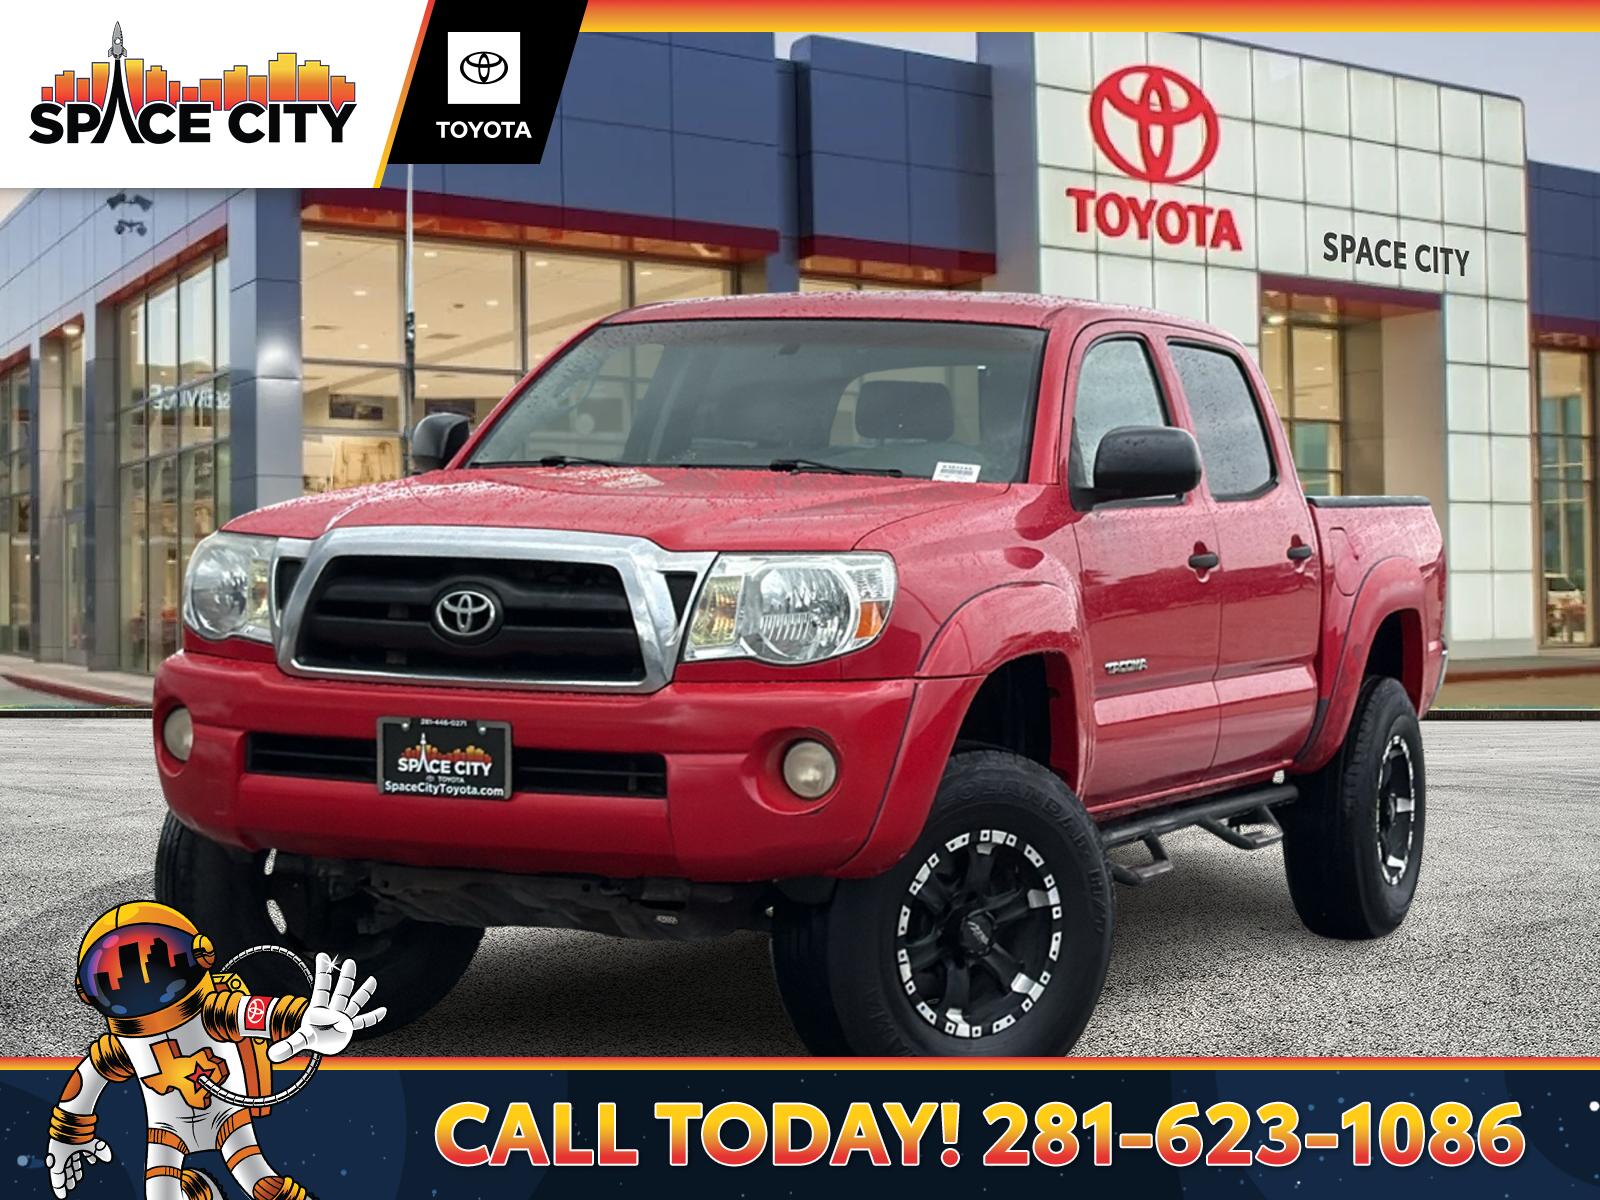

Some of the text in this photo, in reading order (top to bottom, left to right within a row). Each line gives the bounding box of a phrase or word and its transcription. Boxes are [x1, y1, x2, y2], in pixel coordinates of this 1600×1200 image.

[1066, 187, 1243, 251] TOYOTA
[1323, 231, 1470, 277] SPACE CITY
[398, 746, 492, 777] SPACE CITY
[385, 780, 504, 797] SpaceCityToyota.com
[437, 775, 465, 784] TOYOTA
